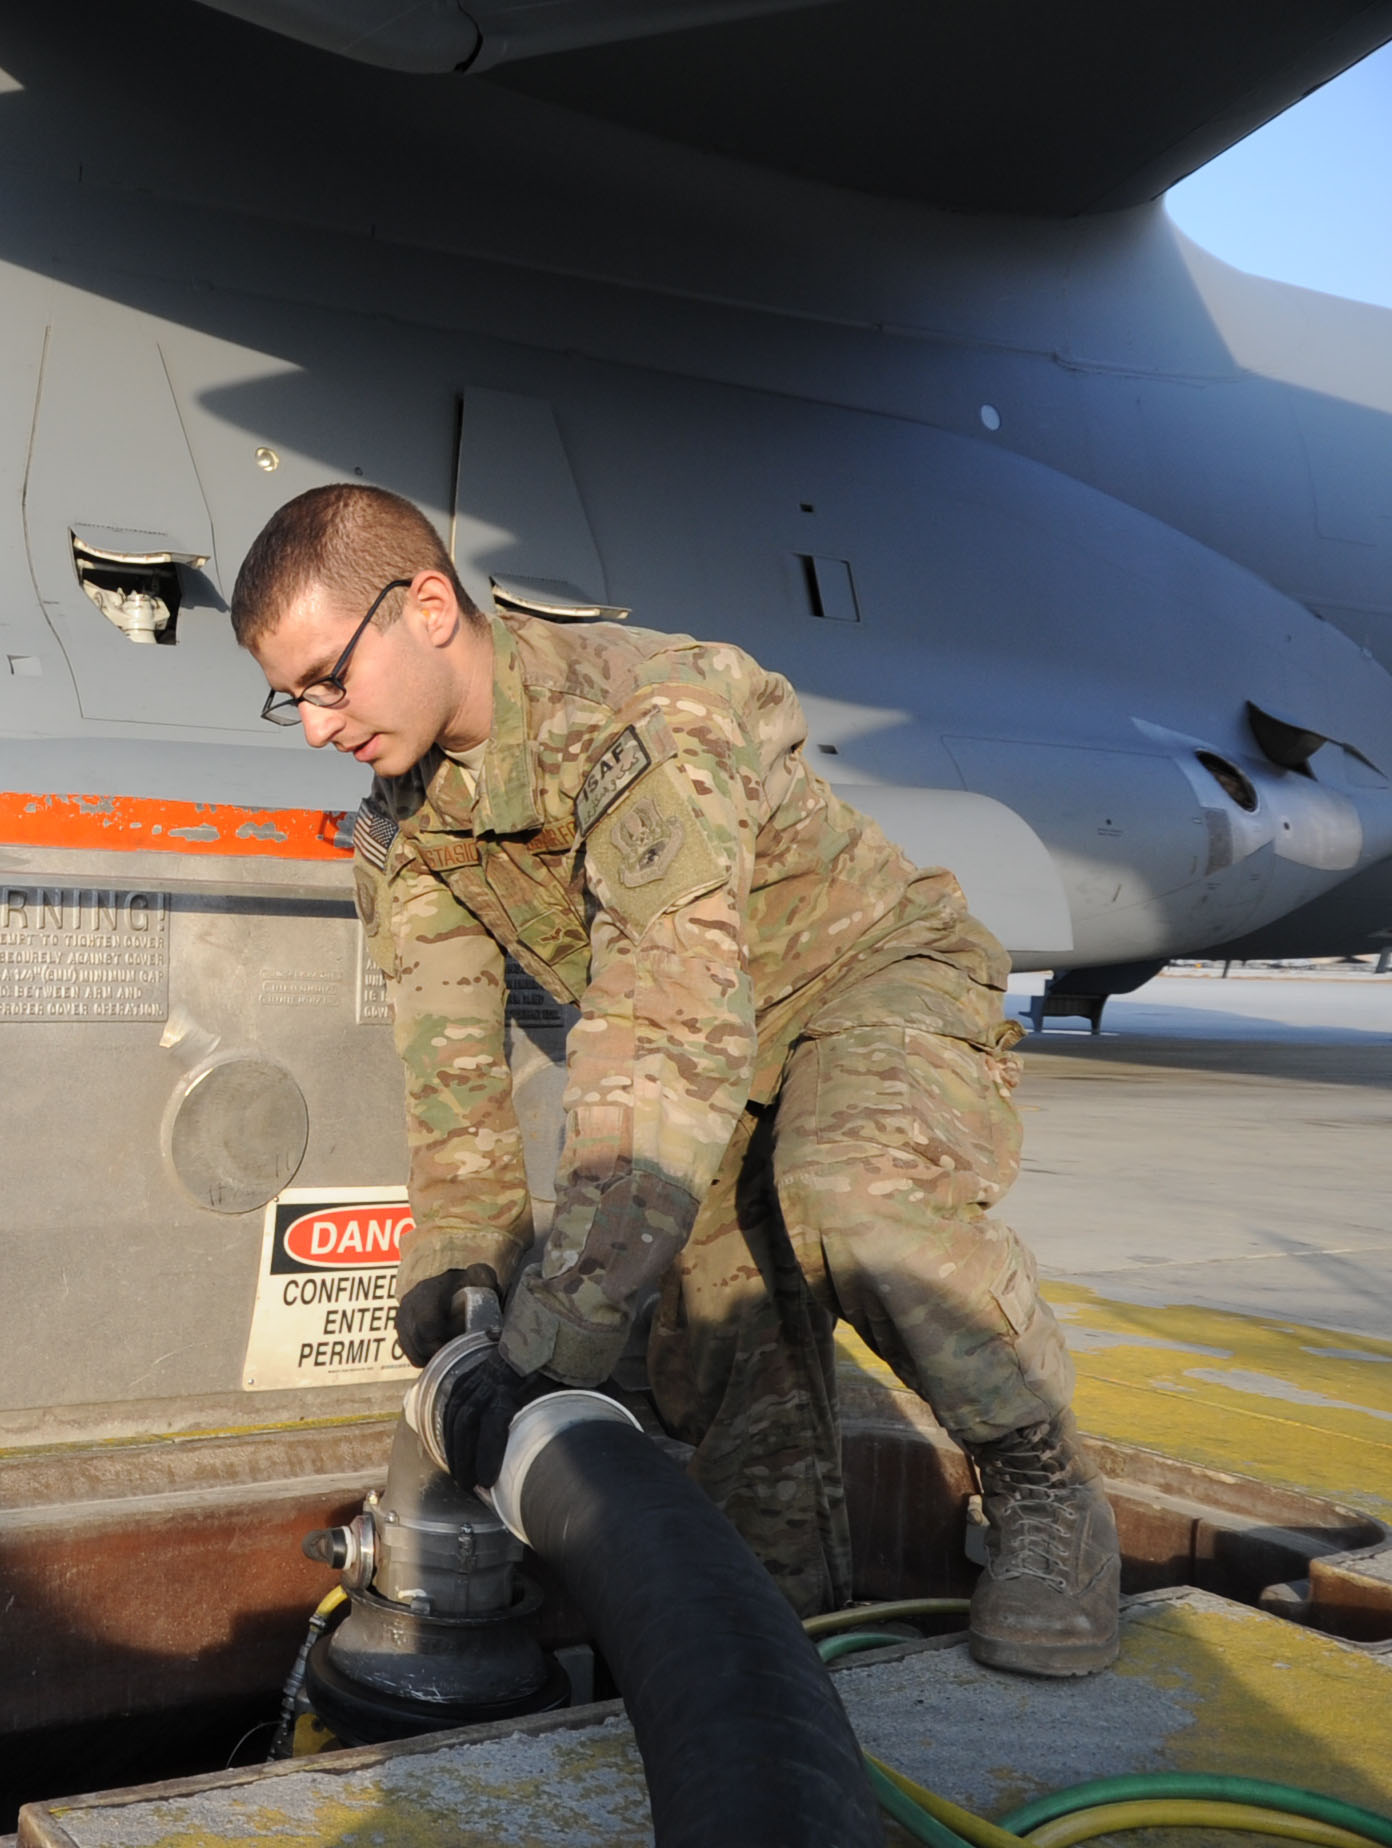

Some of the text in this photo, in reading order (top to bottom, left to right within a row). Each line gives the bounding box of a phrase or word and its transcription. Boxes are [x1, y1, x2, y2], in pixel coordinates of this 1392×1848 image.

[582, 742, 624, 802] ISAF
[41, 933, 59, 946] TO
[64, 934, 121, 948] TIGHTEN
[123, 935, 165, 949] COVER
[67, 952, 122, 966] AGAINST
[124, 952, 165, 966] COVER
[79, 968, 136, 983] MINIMUM
[139, 970, 164, 983] GAP
[14, 985, 80, 999] BETWEEN
[84, 985, 113, 999] ARM
[116, 986, 143, 1000] AND
[47, 1003, 89, 1016] COVER
[298, 1337, 386, 1368] PERMIT
